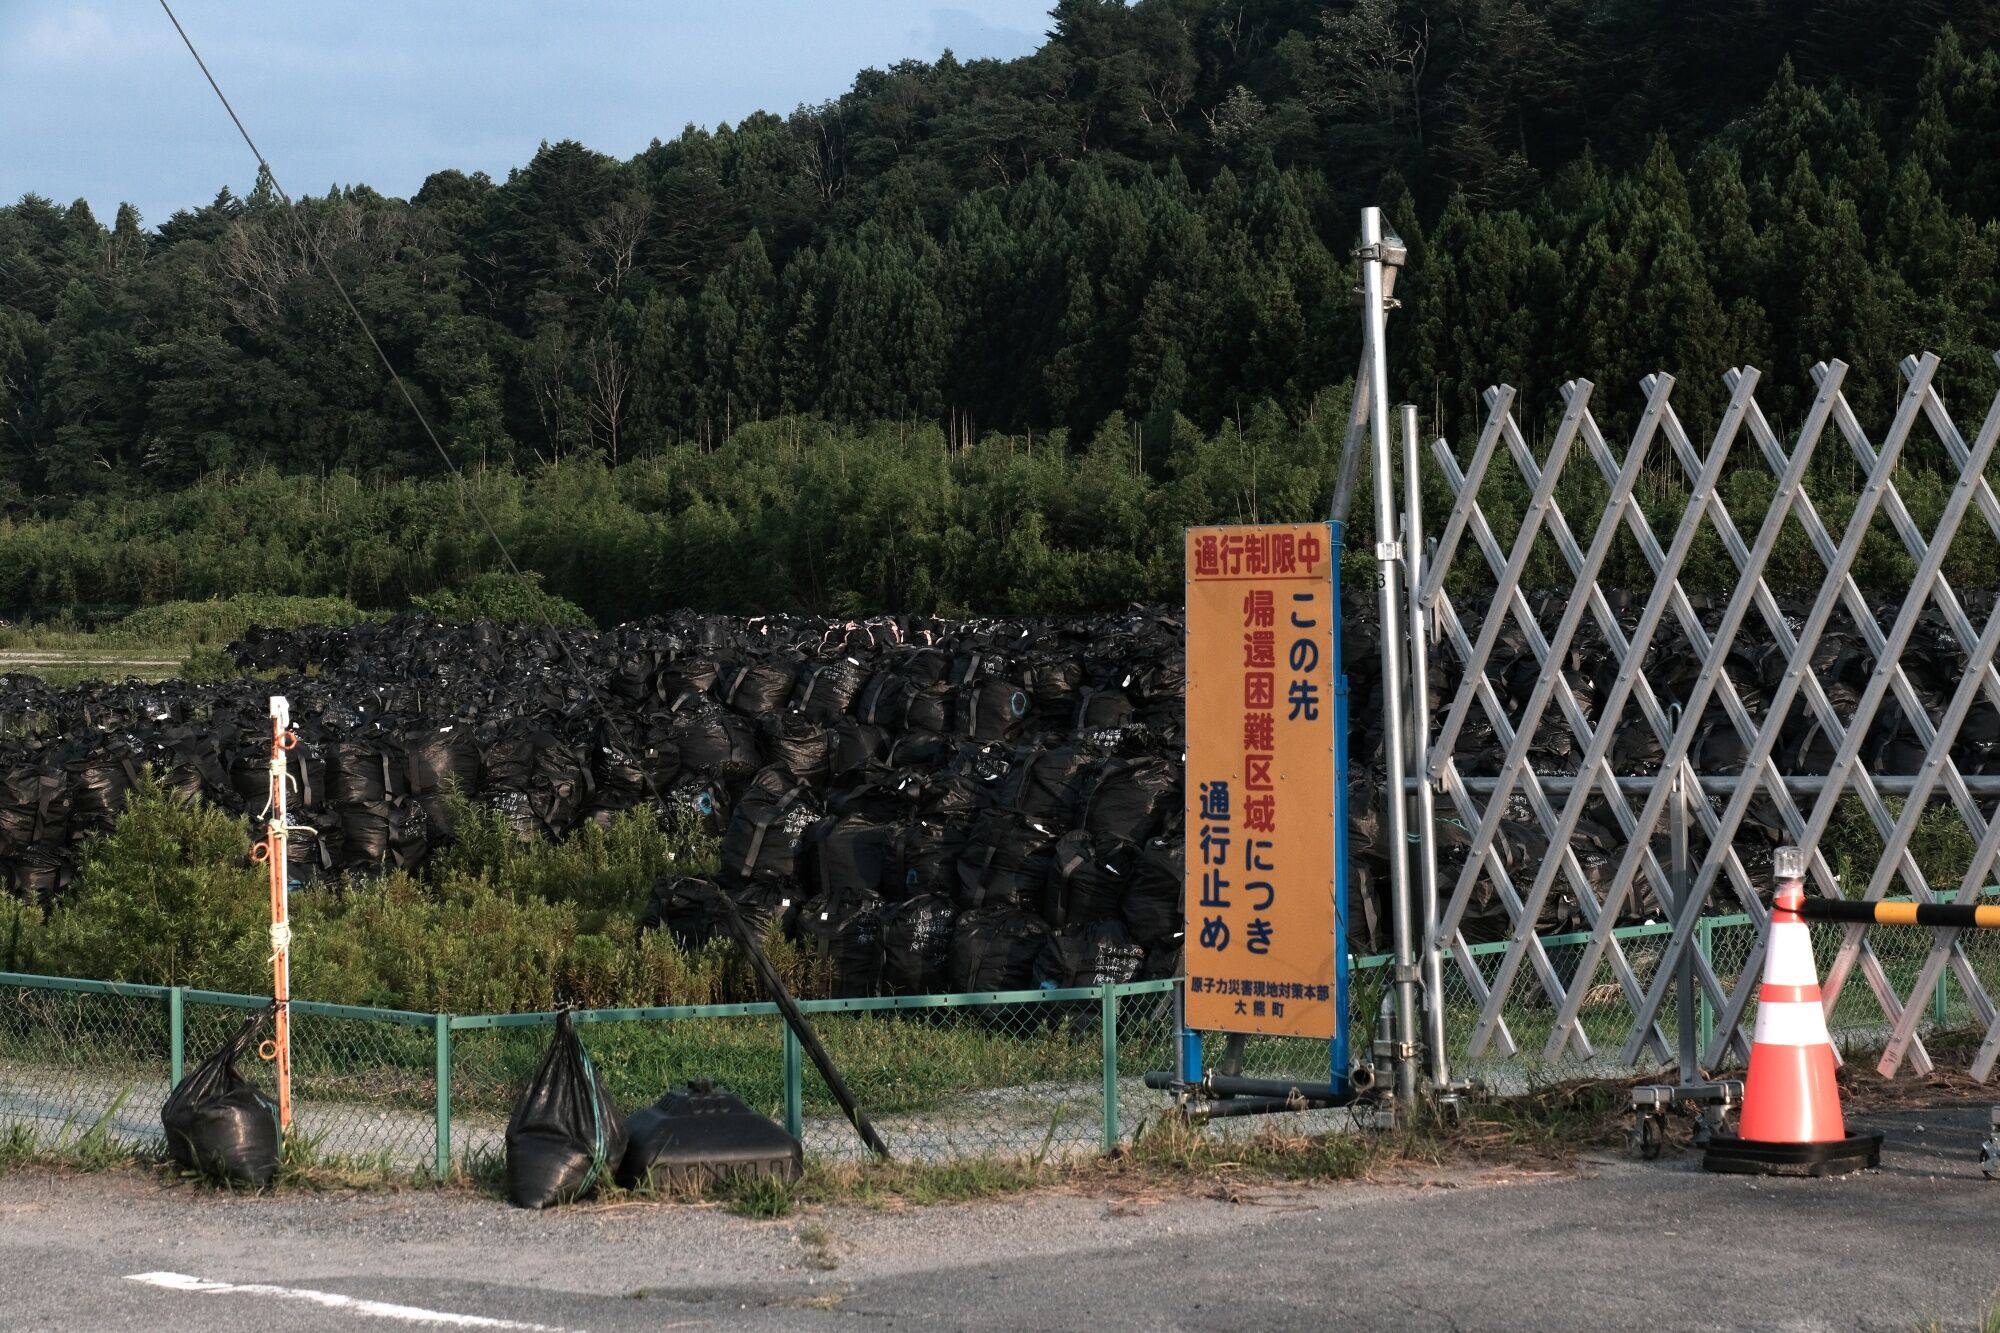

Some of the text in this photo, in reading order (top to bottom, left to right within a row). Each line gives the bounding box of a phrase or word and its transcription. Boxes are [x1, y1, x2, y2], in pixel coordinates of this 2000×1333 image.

[1195, 532, 1321, 575] 通行制限中
[1288, 593, 1319, 721] この先
[1243, 589, 1276, 955] 帰還困難区域につき
[1199, 780, 1231, 952] 通行止め
[1191, 976, 1329, 1002] 原子力災害現地対策本部
[1234, 1000, 1285, 1018] 大熊町
